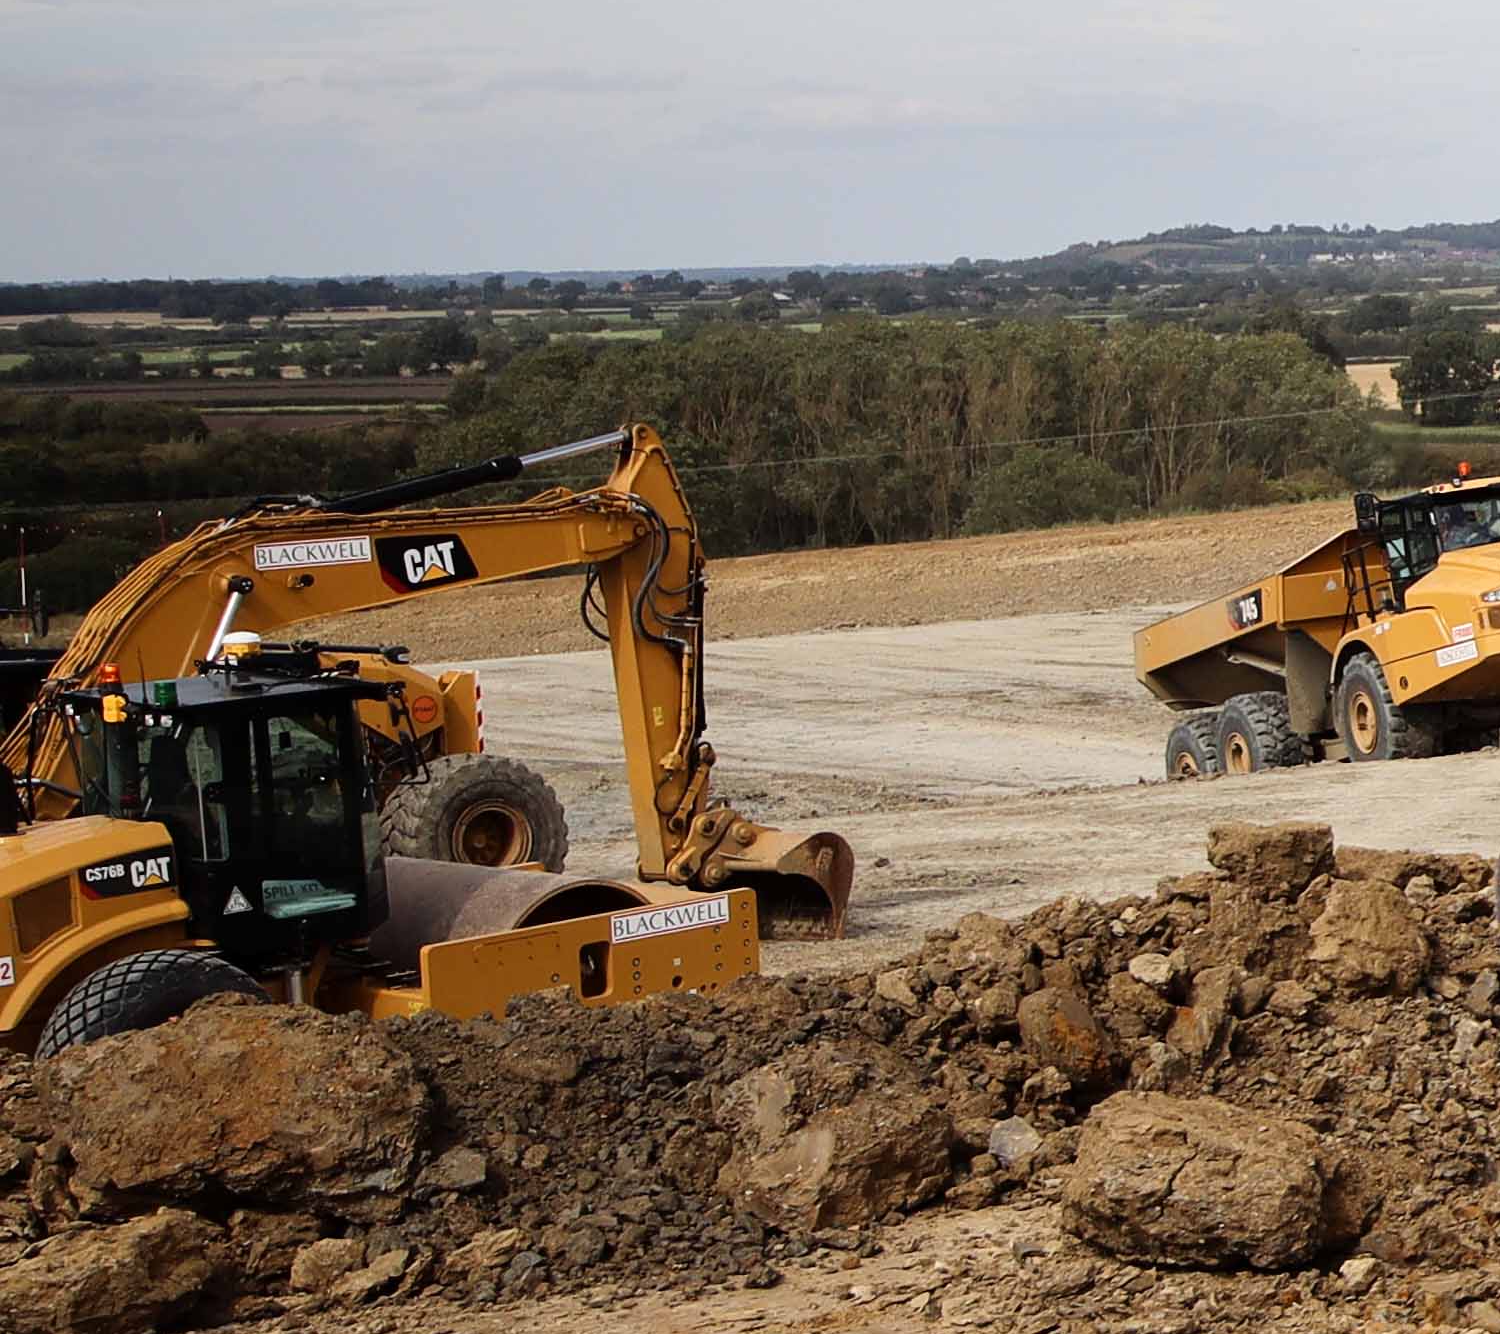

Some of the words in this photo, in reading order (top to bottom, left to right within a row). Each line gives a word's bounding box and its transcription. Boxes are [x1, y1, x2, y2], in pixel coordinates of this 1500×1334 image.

[256, 541, 369, 565] BLACKWELL
[403, 541, 455, 584] CAT
[1239, 597, 1259, 623] 745
[86, 863, 125, 882] CS76B
[130, 856, 170, 888] CAT
[613, 901, 727, 939] BLACKWELL
